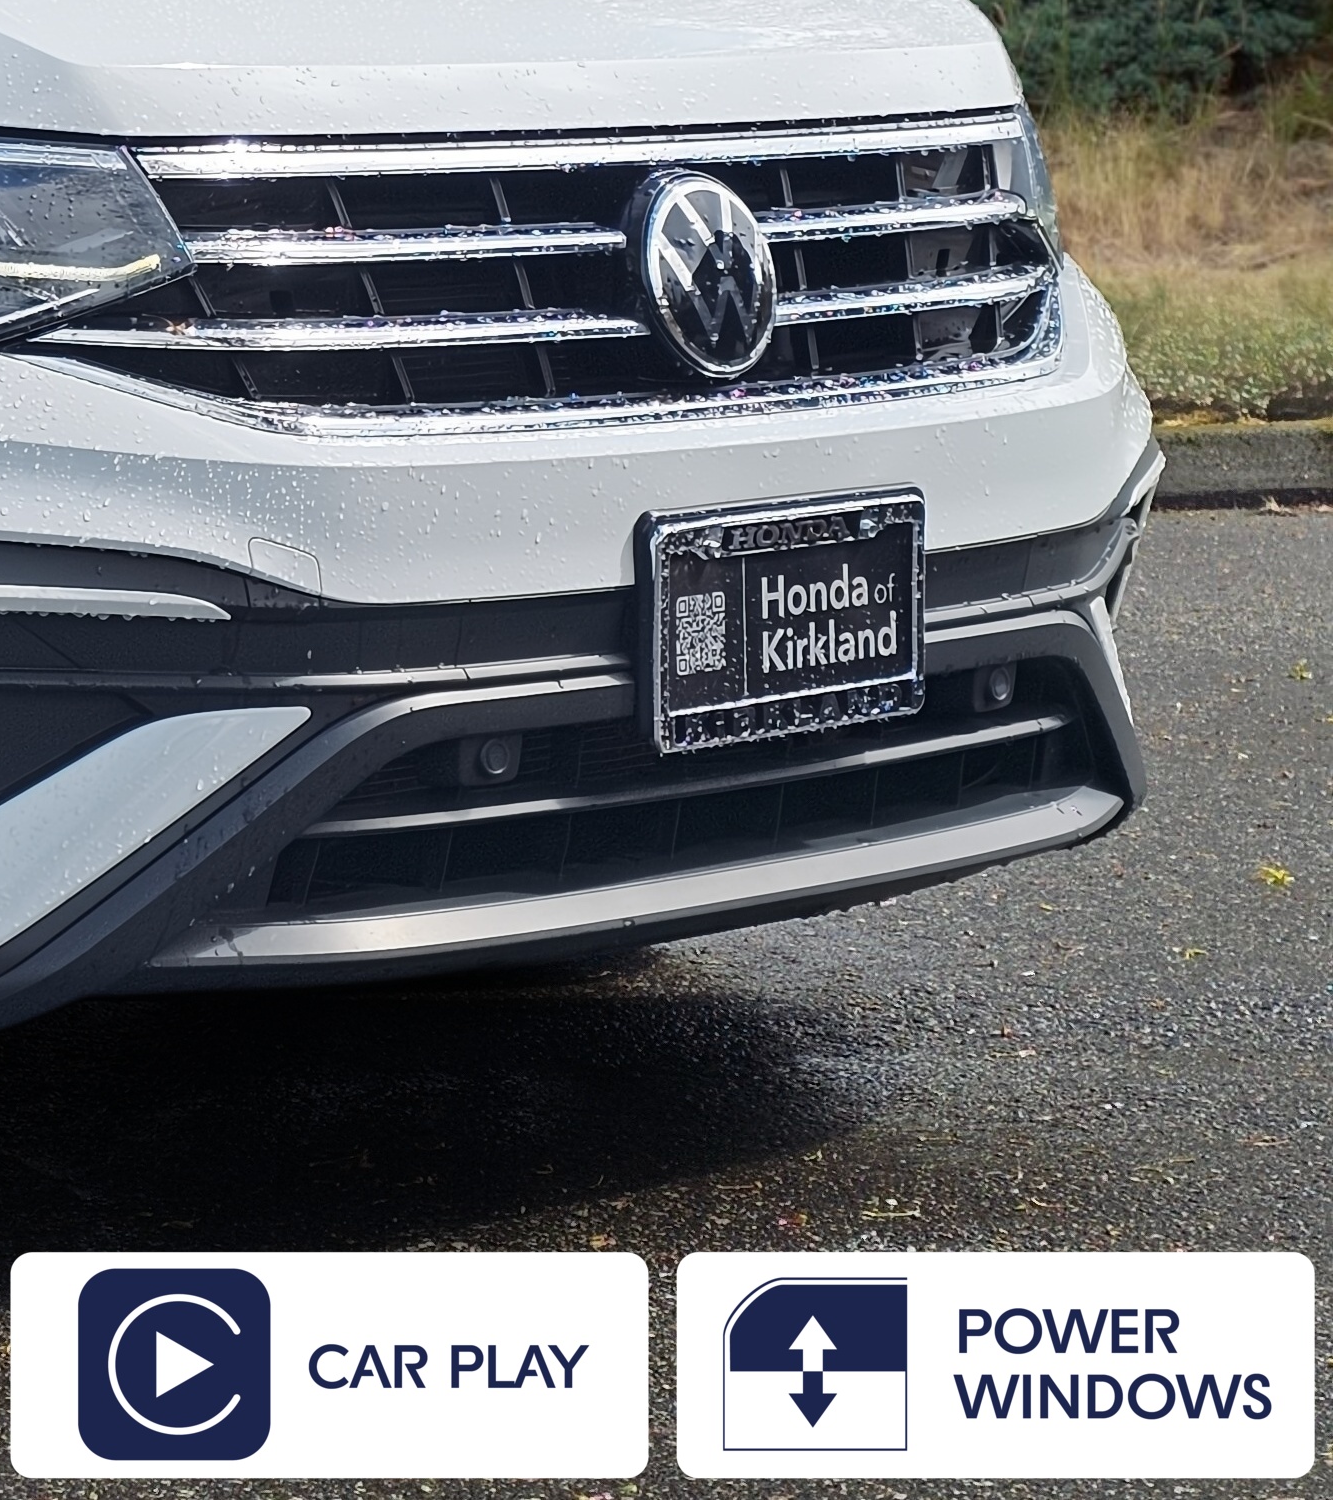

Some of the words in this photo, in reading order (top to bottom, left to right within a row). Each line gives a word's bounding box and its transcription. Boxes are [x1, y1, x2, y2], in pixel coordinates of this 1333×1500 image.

[730, 516, 850, 551] HONDA
[760, 563, 869, 619] Honda
[873, 573, 896, 604] of
[762, 610, 897, 673] Kirkland
